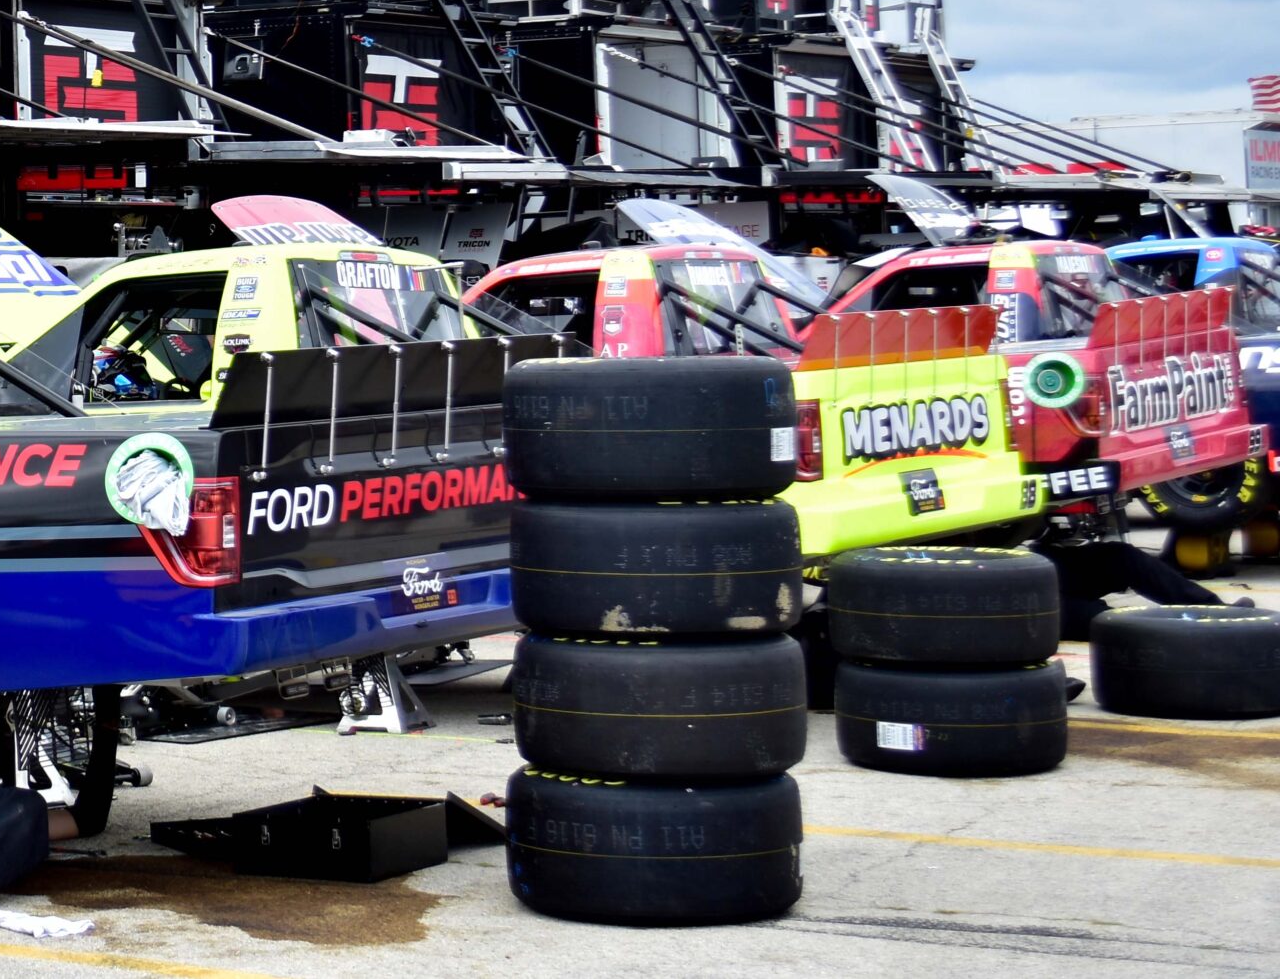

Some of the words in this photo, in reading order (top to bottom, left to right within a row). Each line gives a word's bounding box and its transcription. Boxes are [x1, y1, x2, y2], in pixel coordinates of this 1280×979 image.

[1249, 139, 1280, 162] ILM
[384, 236, 419, 247] YOTA
[457, 240, 491, 248] TRICON
[1108, 352, 1229, 437] FarmPaint
[842, 394, 990, 461] MENARDS
[247, 484, 335, 536] FORD
[401, 566, 444, 597] Ford
[611, 824, 643, 849] PN
